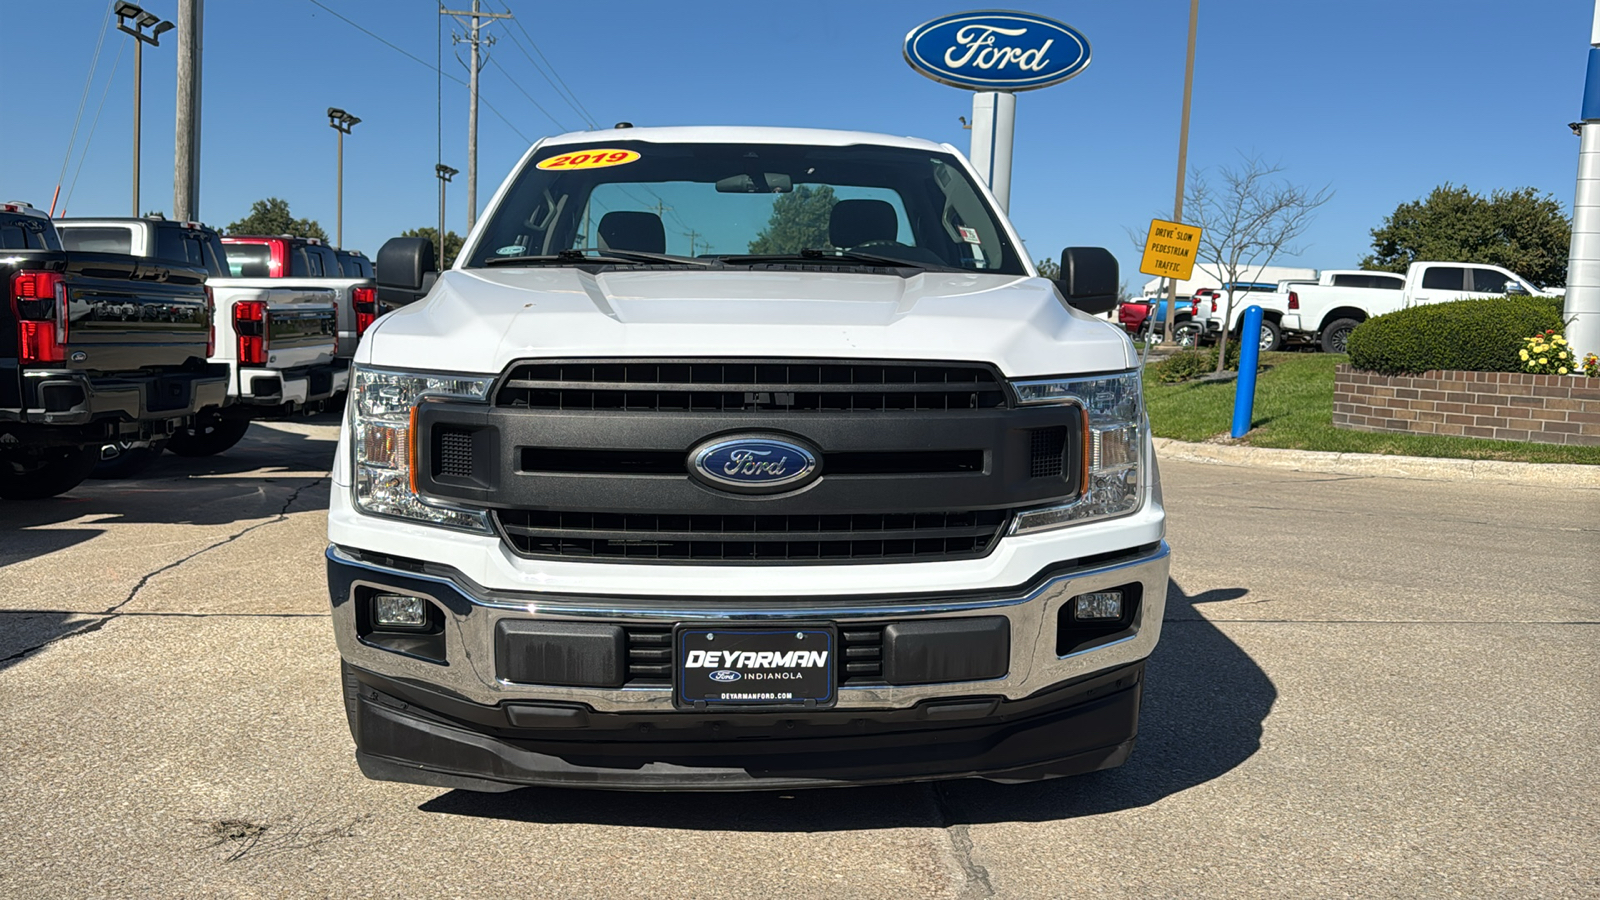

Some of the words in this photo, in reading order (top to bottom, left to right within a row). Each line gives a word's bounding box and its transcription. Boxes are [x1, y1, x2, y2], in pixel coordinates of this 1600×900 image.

[944, 24, 1055, 72] Ford
[546, 152, 629, 168] 2019
[1154, 227, 1175, 239] DRIVE
[1176, 231, 1194, 242] SLOW
[1151, 243, 1190, 257] PEDESTRIAN
[1155, 259, 1181, 272] TRAFFIC
[723, 448, 787, 476] Ford
[685, 650, 829, 668] DEYARMAN
[715, 671, 735, 680] Ford
[744, 672, 803, 680] INDIANOLA
[721, 692, 793, 700] DEYARMANFORD.COM
